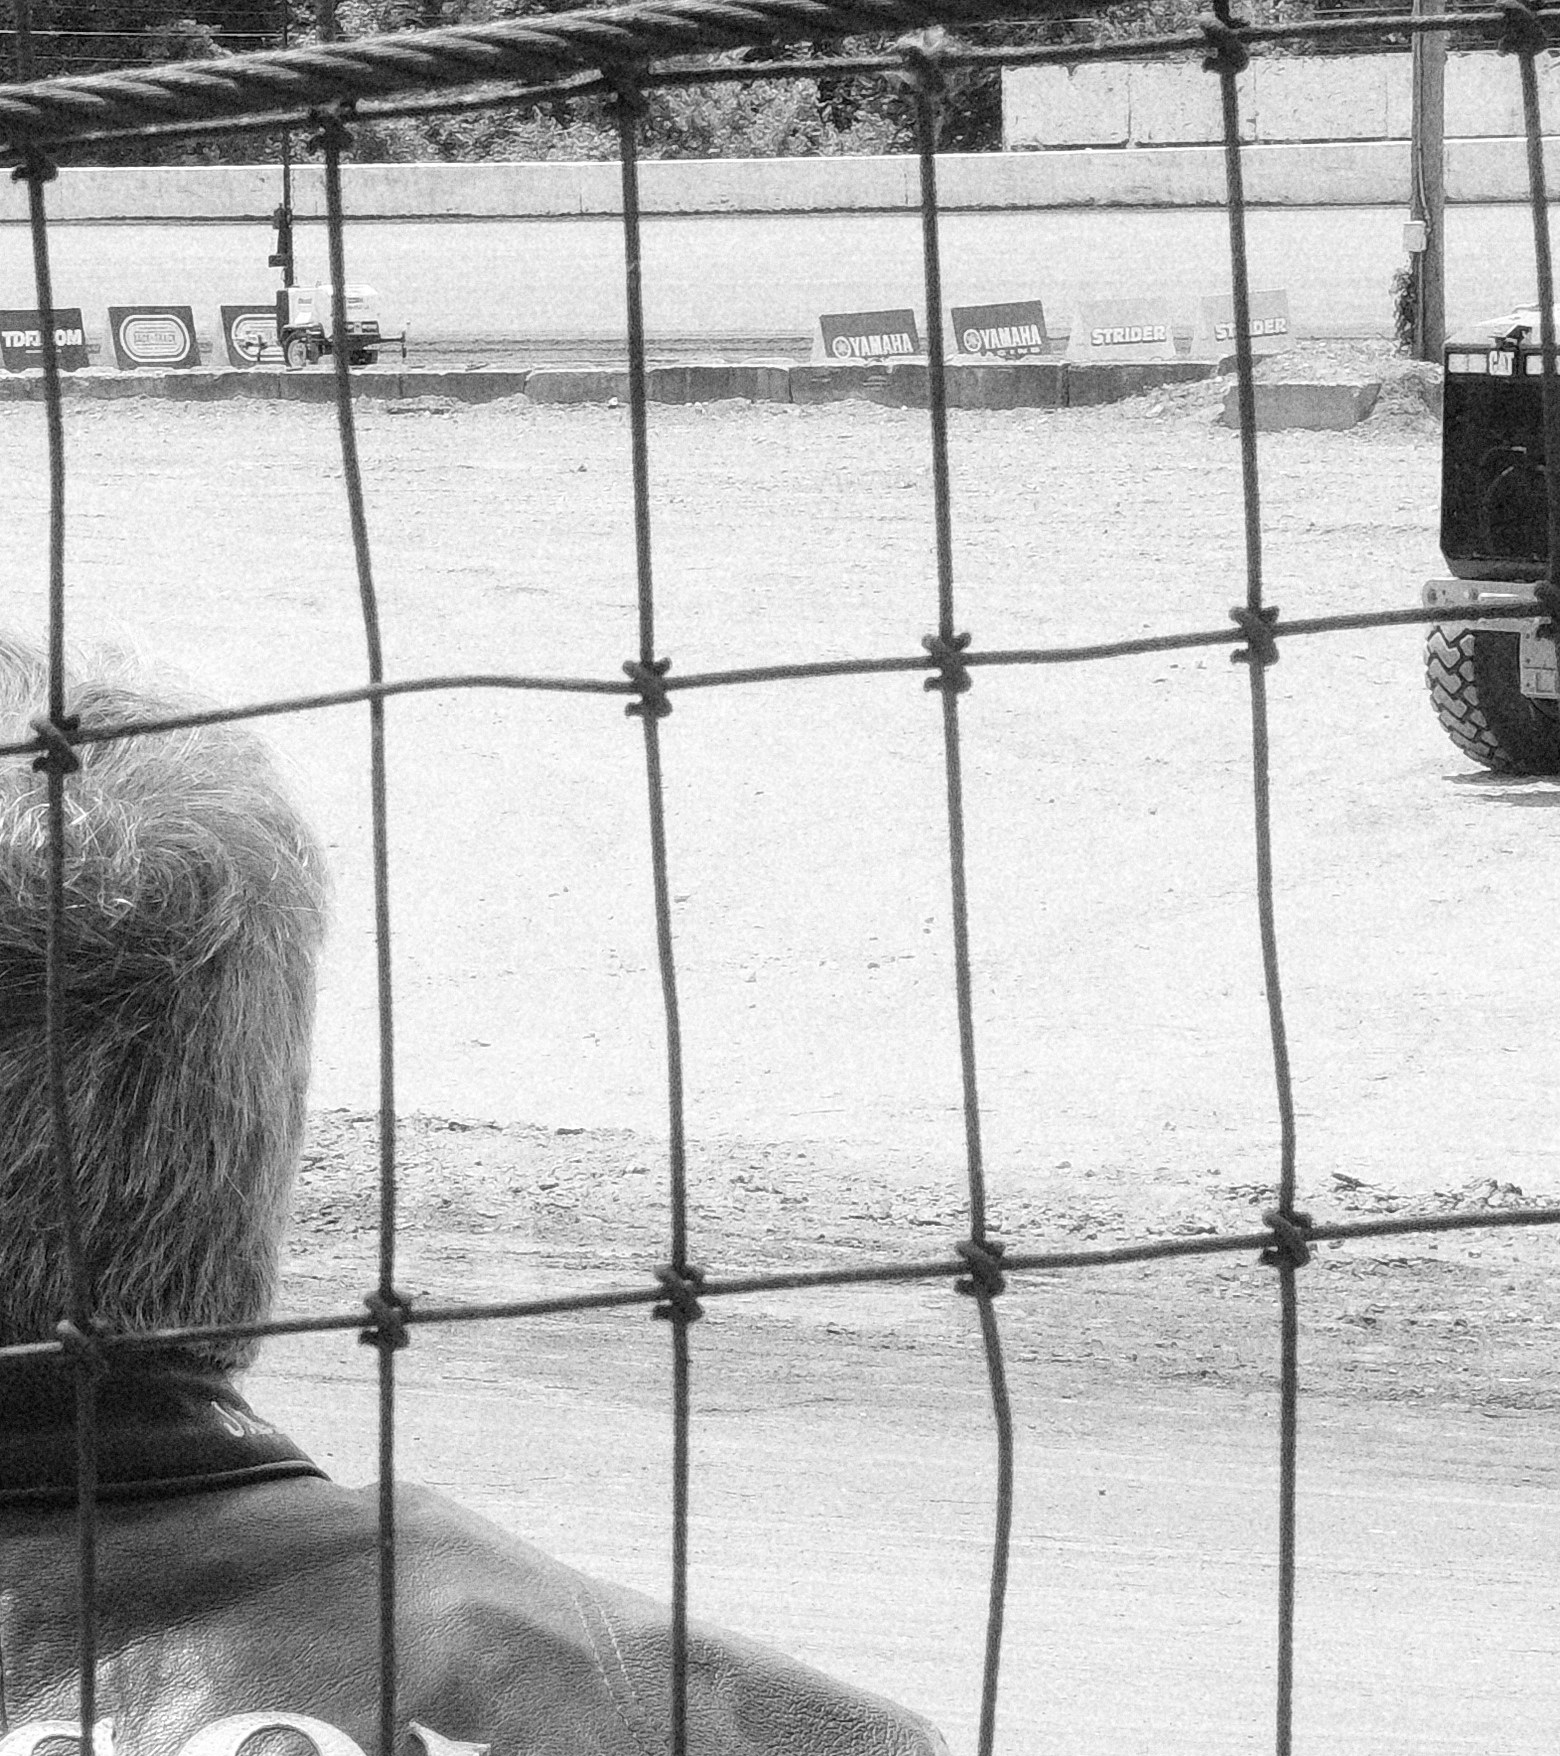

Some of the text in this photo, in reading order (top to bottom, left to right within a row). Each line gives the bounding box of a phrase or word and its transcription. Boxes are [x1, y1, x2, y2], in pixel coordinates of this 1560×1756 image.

[980, 324, 1042, 350] YAMAHA
[1091, 325, 1167, 346] STRIDER
[1215, 317, 1287, 342] STDER
[848, 333, 914, 357] YAMAHA
[1489, 350, 1515, 376] CAT
